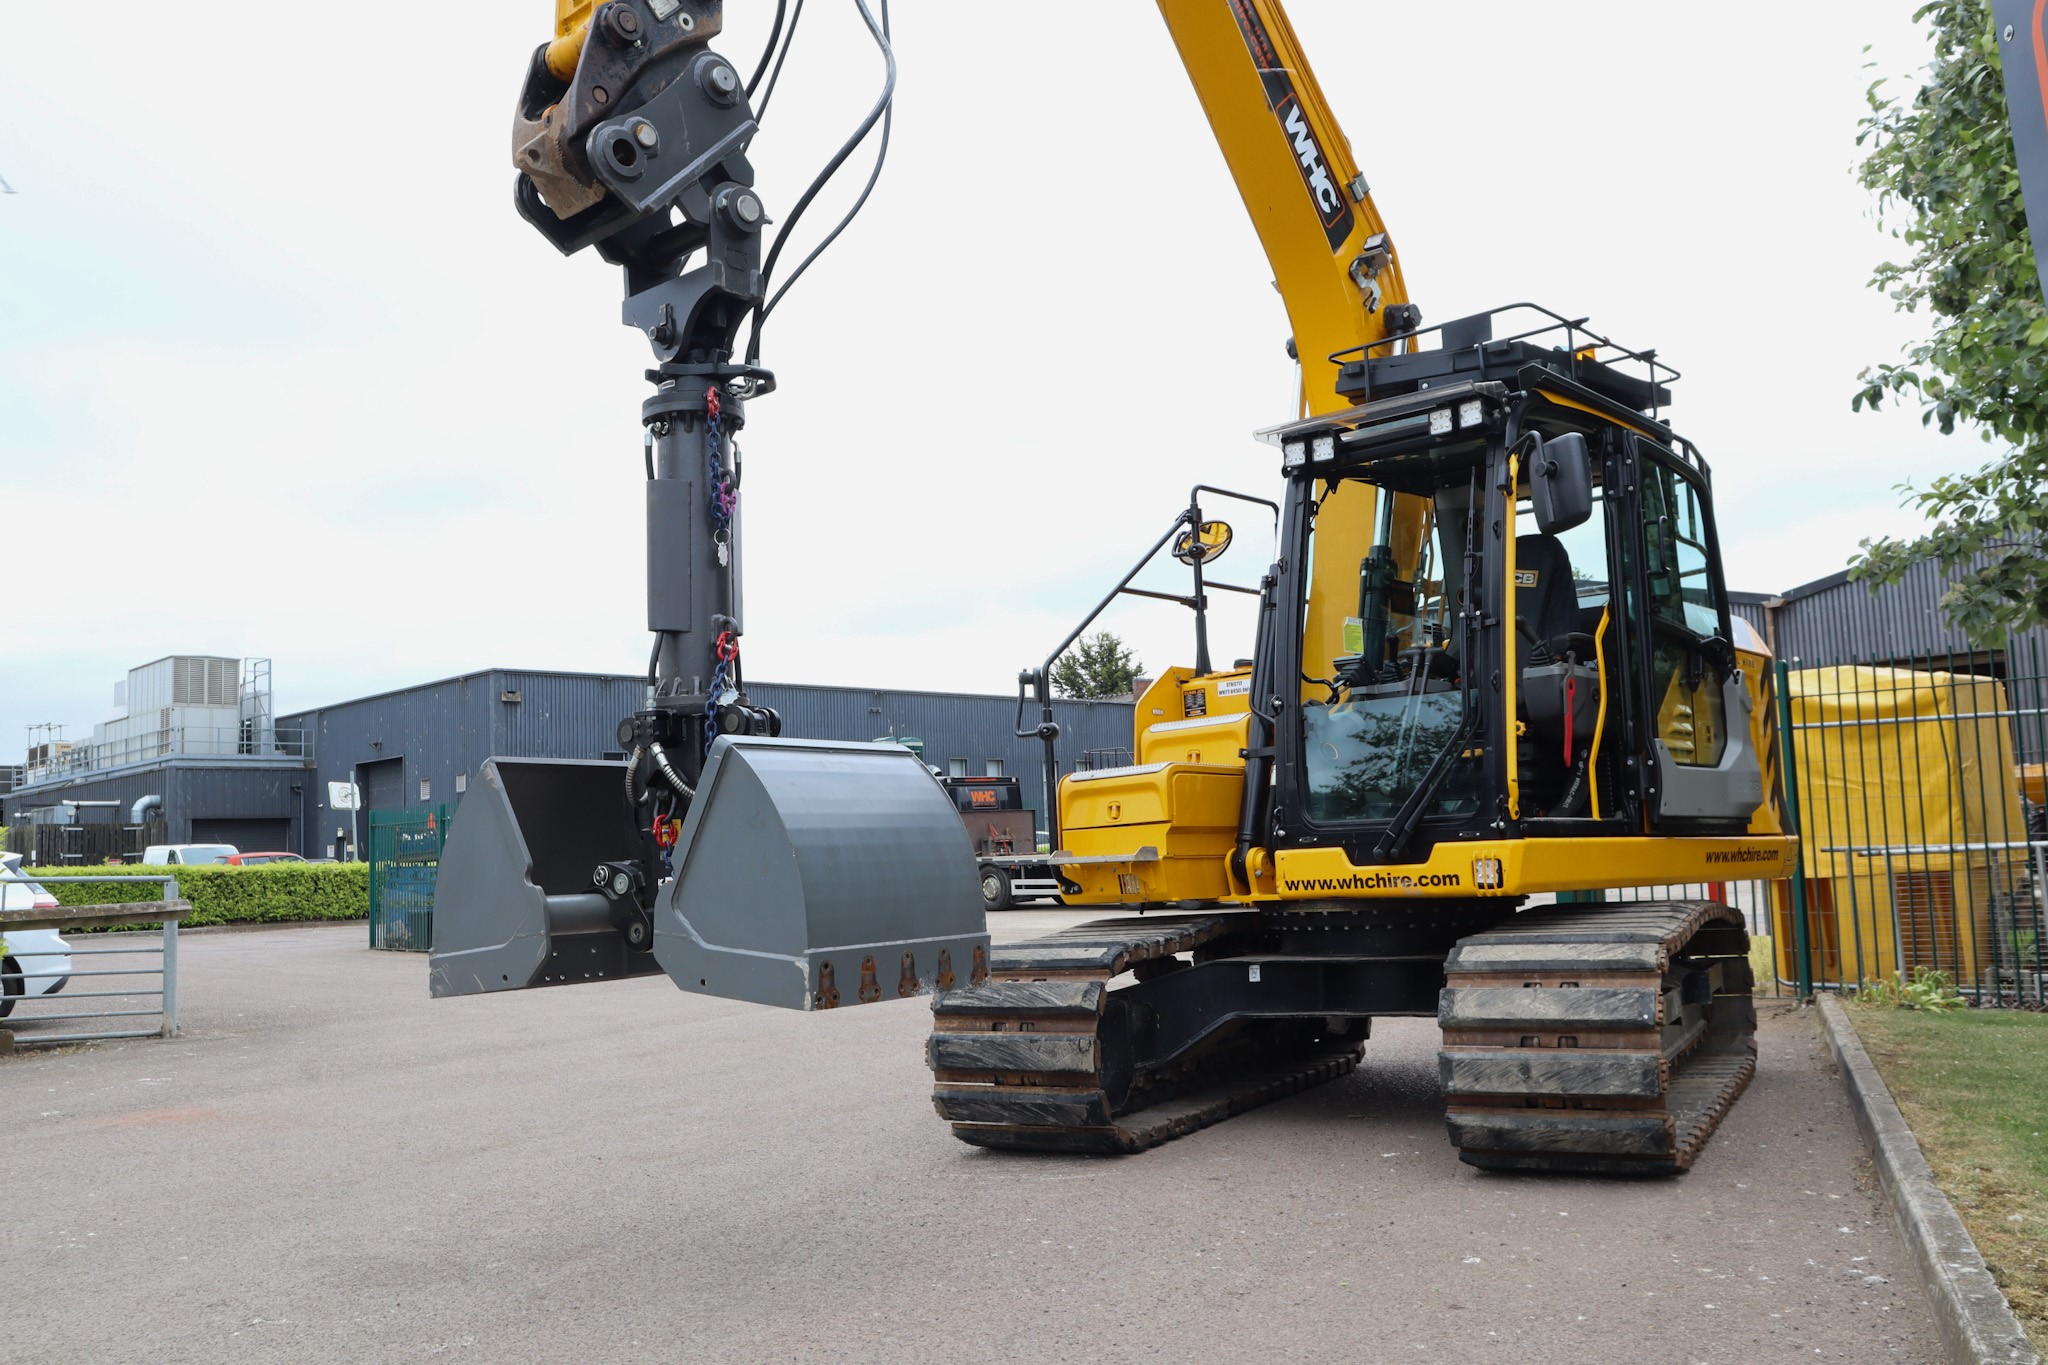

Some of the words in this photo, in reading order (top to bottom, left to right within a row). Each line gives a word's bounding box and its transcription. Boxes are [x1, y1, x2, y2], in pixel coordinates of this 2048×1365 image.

[1254, 26, 1273, 60] HIRE
[1285, 103, 1338, 213] WHC
[1515, 574, 1534, 583] CB
[971, 791, 996, 802] WHC
[1706, 846, 1779, 864] www.whchire.com
[1285, 873, 1460, 891] www.whchire.com
